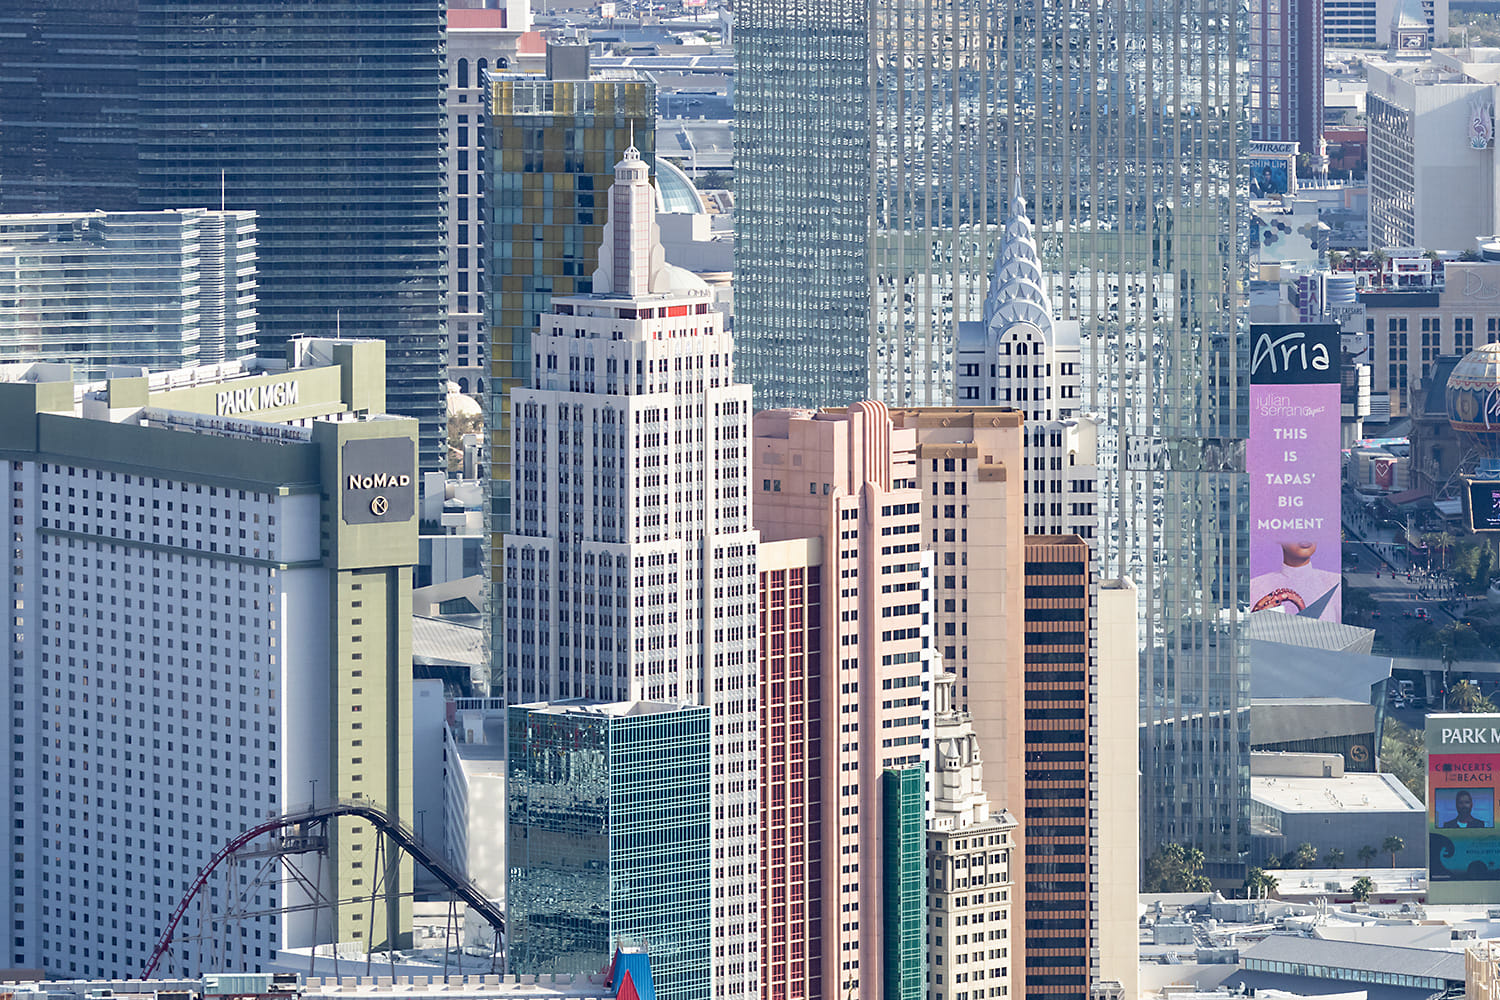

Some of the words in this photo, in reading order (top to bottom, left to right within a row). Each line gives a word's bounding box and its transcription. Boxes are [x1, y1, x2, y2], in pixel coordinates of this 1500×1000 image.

[1252, 143, 1292, 153] MIRAGE
[1251, 332, 1330, 375] Aria
[216, 387, 257, 416] PARK
[259, 380, 299, 411] MGM
[1273, 428, 1308, 440] THIS
[1284, 451, 1297, 462] IS
[1265, 473, 1316, 485] TAPAS'
[1278, 496, 1304, 507] BIG
[1257, 518, 1324, 530] MOMENT
[1442, 728, 1487, 744] PARK
[1457, 774, 1492, 782] BEACH
